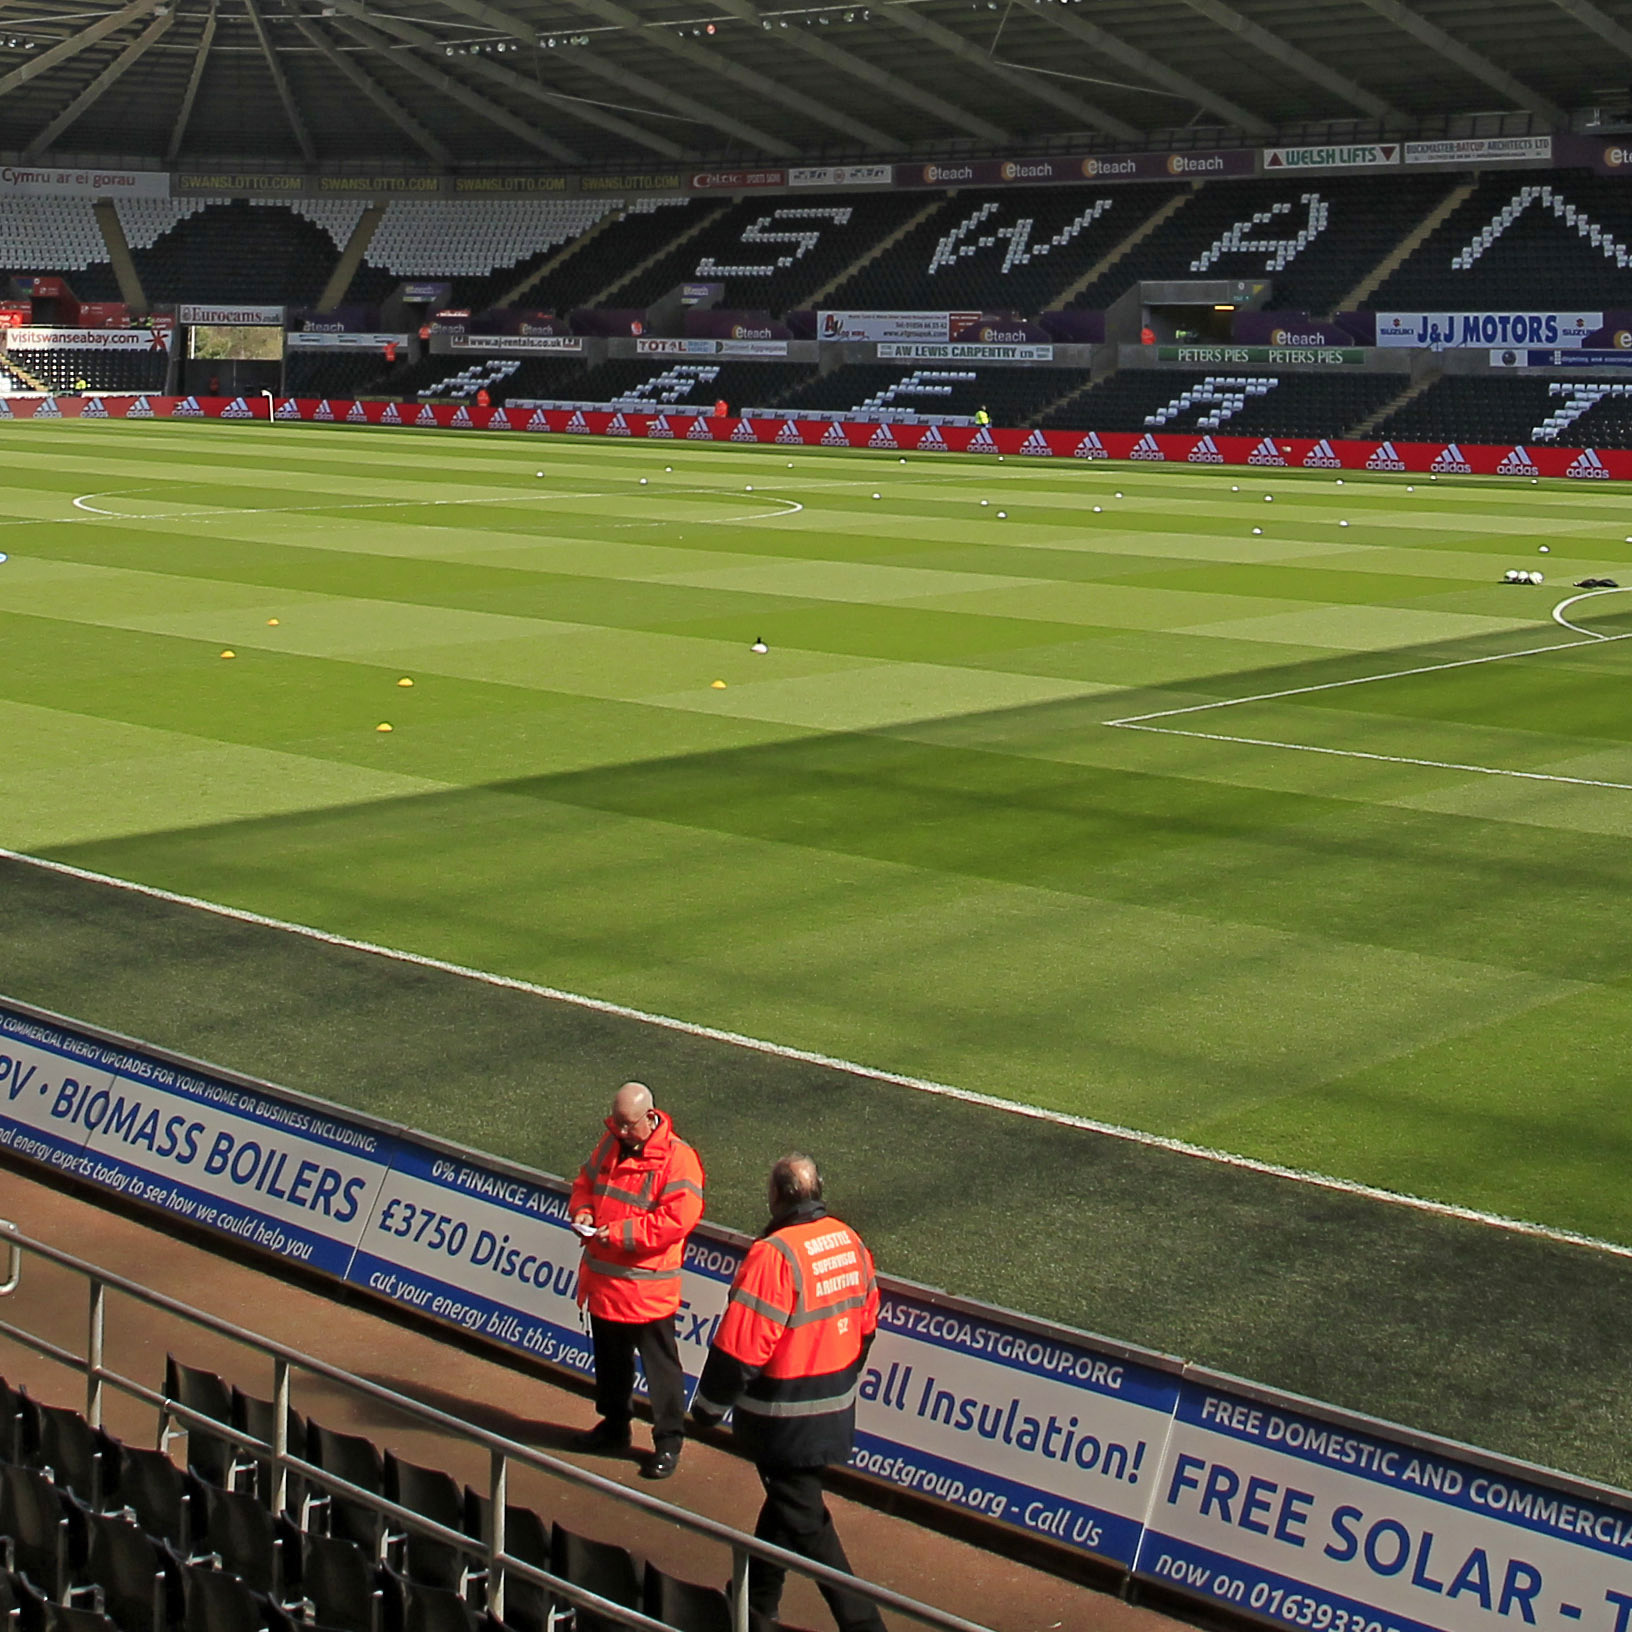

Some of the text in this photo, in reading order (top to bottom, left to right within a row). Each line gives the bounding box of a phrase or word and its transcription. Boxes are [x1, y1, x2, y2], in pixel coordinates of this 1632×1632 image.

[1285, 145, 1377, 166] WELSH LIFTS
[1, 168, 136, 189] Cymru ar ei gorau
[180, 174, 302, 190] SWANSLOTTO.COM
[321, 176, 439, 192] SWANSLOTTO.COM
[455, 177, 566, 192] SWANSLOTTO.COM
[581, 175, 680, 191] SWANSLOTTO.COM
[11, 330, 140, 347] visitswanseabay.com
[1380, 328, 1415, 337] SUZUKI
[1418, 314, 1559, 345] J&J MOTORS
[894, 345, 913, 358] AW
[915, 345, 949, 358] LEWIS
[951, 346, 1017, 359] CARPENTRY
[1177, 347, 1249, 363] PETERS PIES
[1268, 348, 1344, 365] PETERS PIES
[1130, 450, 1165, 462] adidas
[3, 1016, 64, 1048] COMMERCIAL
[62, 1037, 102, 1060] ENERGY
[152, 1067, 175, 1086] FOR
[175, 1074, 205, 1096] YOUR
[204, 1085, 238, 1107] HOME
[239, 1095, 257, 1113] OR
[256, 1100, 310, 1131] BUSINESS
[309, 1115, 378, 1154] INCLUDING:
[50, 1077, 206, 1165] BIOMASS
[203, 1131, 367, 1223] BOILERS
[13, 1135, 53, 1162] energy
[51, 1149, 93, 1176] experts
[92, 1161, 128, 1193] today
[127, 1176, 144, 1196] to
[143, 1186, 166, 1205] see
[166, 1188, 199, 1215] how
[196, 1202, 218, 1224] we
[217, 1210, 254, 1239] could
[253, 1222, 285, 1252] help
[285, 1237, 314, 1263] you
[431, 1159, 572, 1222] 0% FINANCE AVAIL
[377, 1197, 578, 1301] £3750 Discou
[369, 1271, 397, 1294] cut
[394, 1279, 432, 1307] your
[431, 1294, 485, 1331] energy
[486, 1309, 522, 1344] bills
[522, 1325, 554, 1356] this
[877, 1301, 1125, 1390] AST2COASTGROUP.ORG
[858, 1361, 1147, 1485] all Insulation!
[1201, 1396, 1265, 1436] FREE
[1265, 1415, 1401, 1478] DOMESTIC
[1401, 1458, 1464, 1496] AND
[1023, 1501, 1072, 1537] Call
[1071, 1516, 1104, 1548] Us
[1166, 1451, 1545, 1628] FREE SOLAR
[1154, 1553, 1246, 1602] now on
